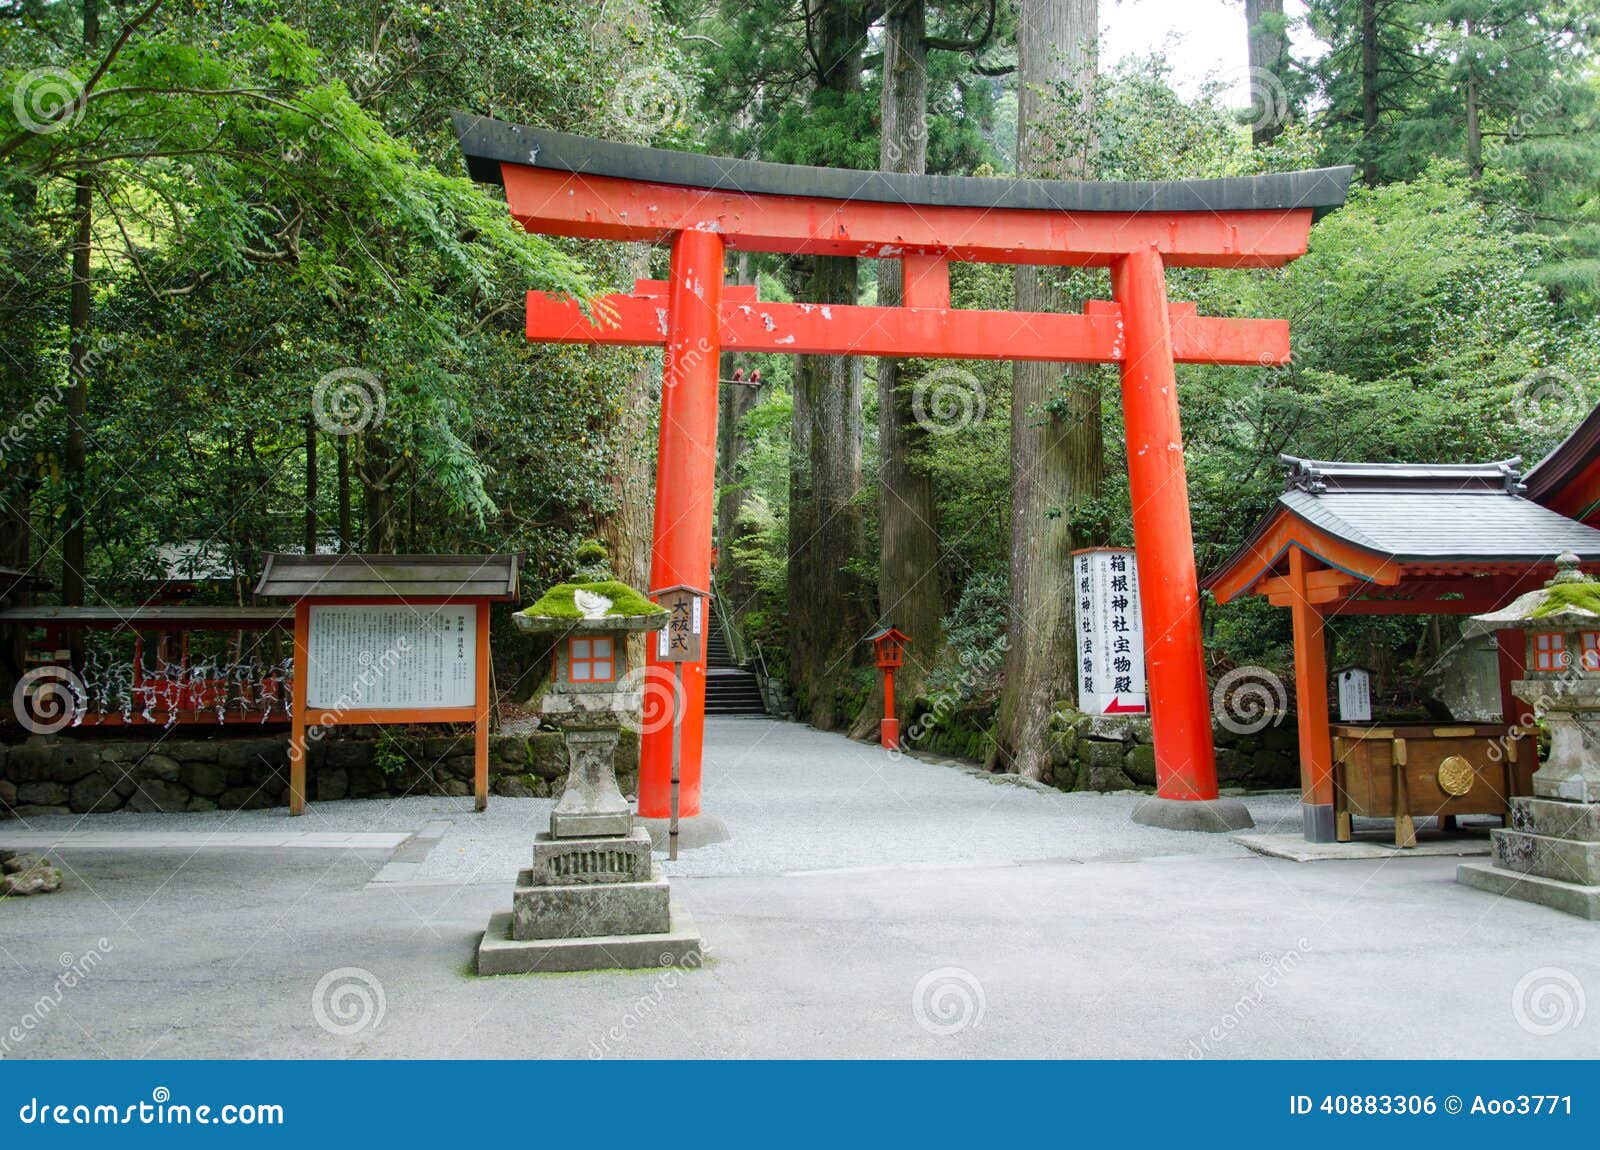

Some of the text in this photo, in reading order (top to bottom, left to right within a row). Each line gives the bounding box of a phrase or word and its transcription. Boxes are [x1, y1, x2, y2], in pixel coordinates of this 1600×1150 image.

[1081, 556, 1094, 693] 箱根神社宝物殿
[1110, 554, 1133, 694] 箱根神社宝物殿
